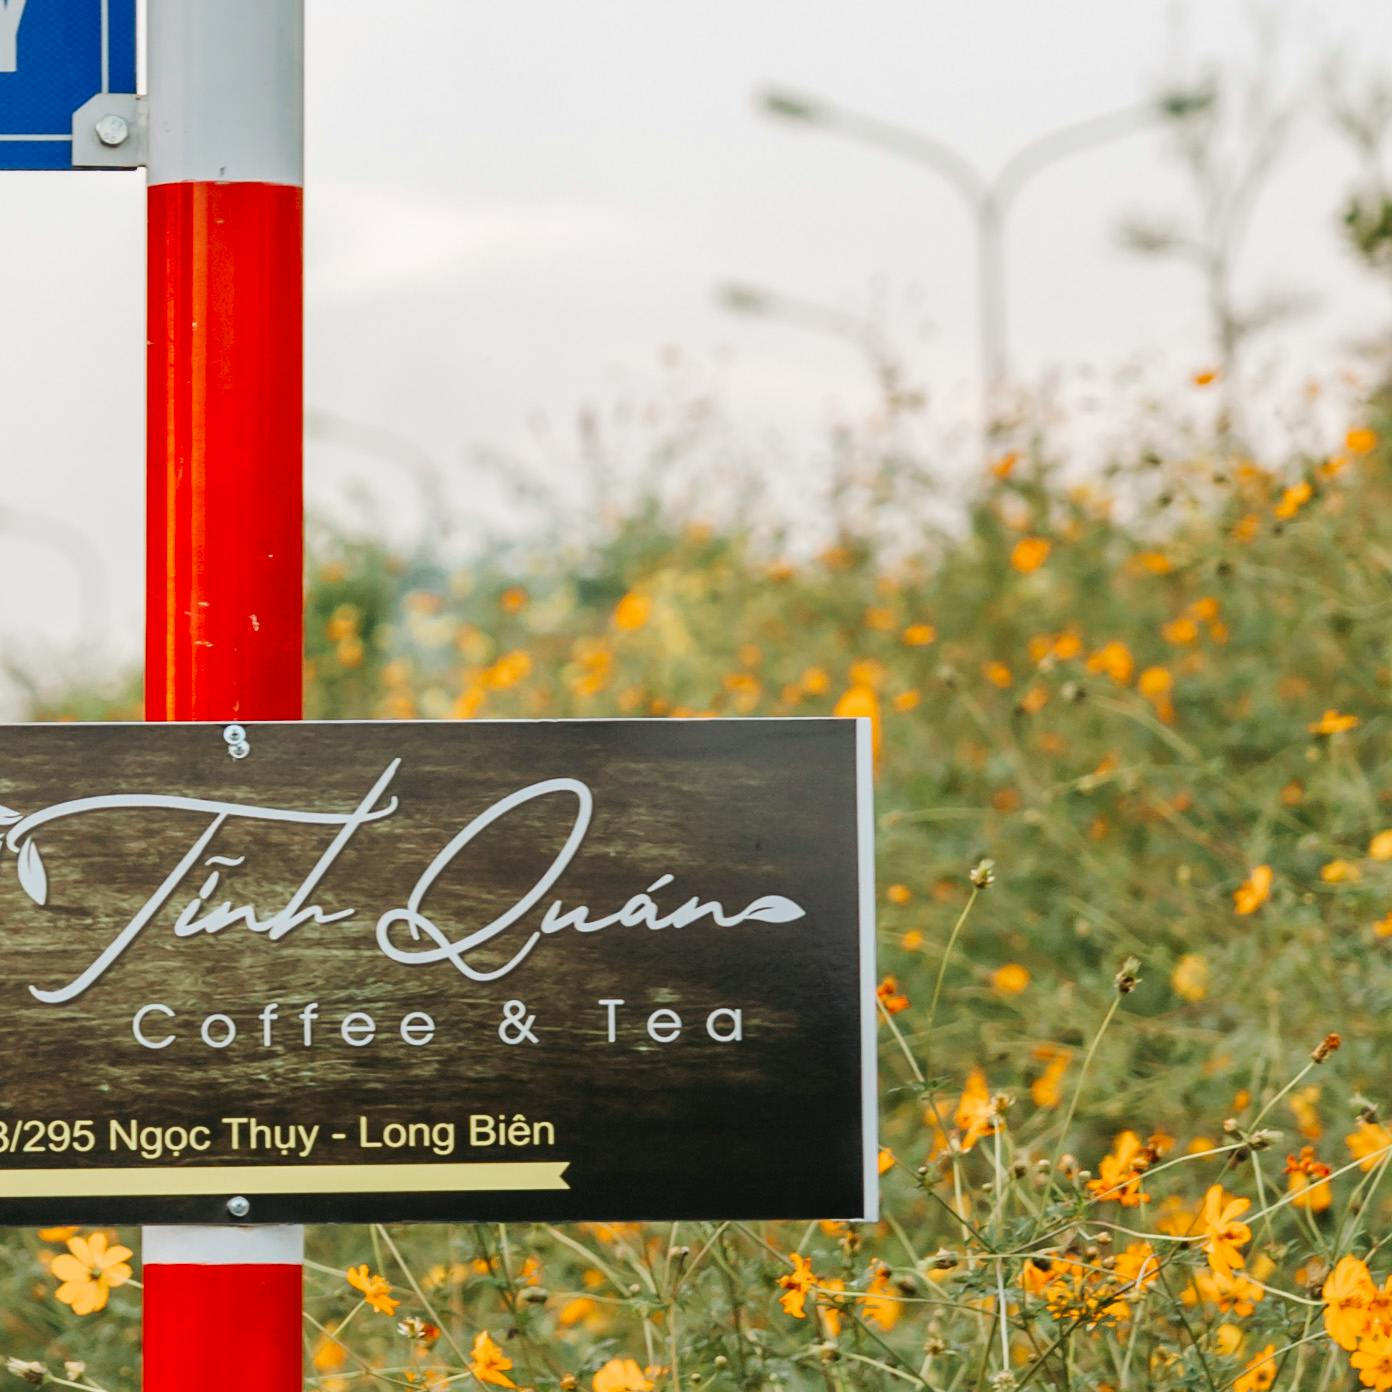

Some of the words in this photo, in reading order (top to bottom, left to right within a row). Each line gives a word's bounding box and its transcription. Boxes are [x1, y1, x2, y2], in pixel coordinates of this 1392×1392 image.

[6, 756, 402, 1004] Tĩnh
[375, 777, 758, 982] Quán
[131, 1001, 436, 1050] Coffee
[497, 998, 540, 1046] &
[597, 998, 743, 1044] Tea
[108, 1118, 212, 1160] Ngọc
[220, 1116, 321, 1158] Thụy
[358, 1115, 456, 1157] Long
[469, 1112, 556, 1147] Biên
